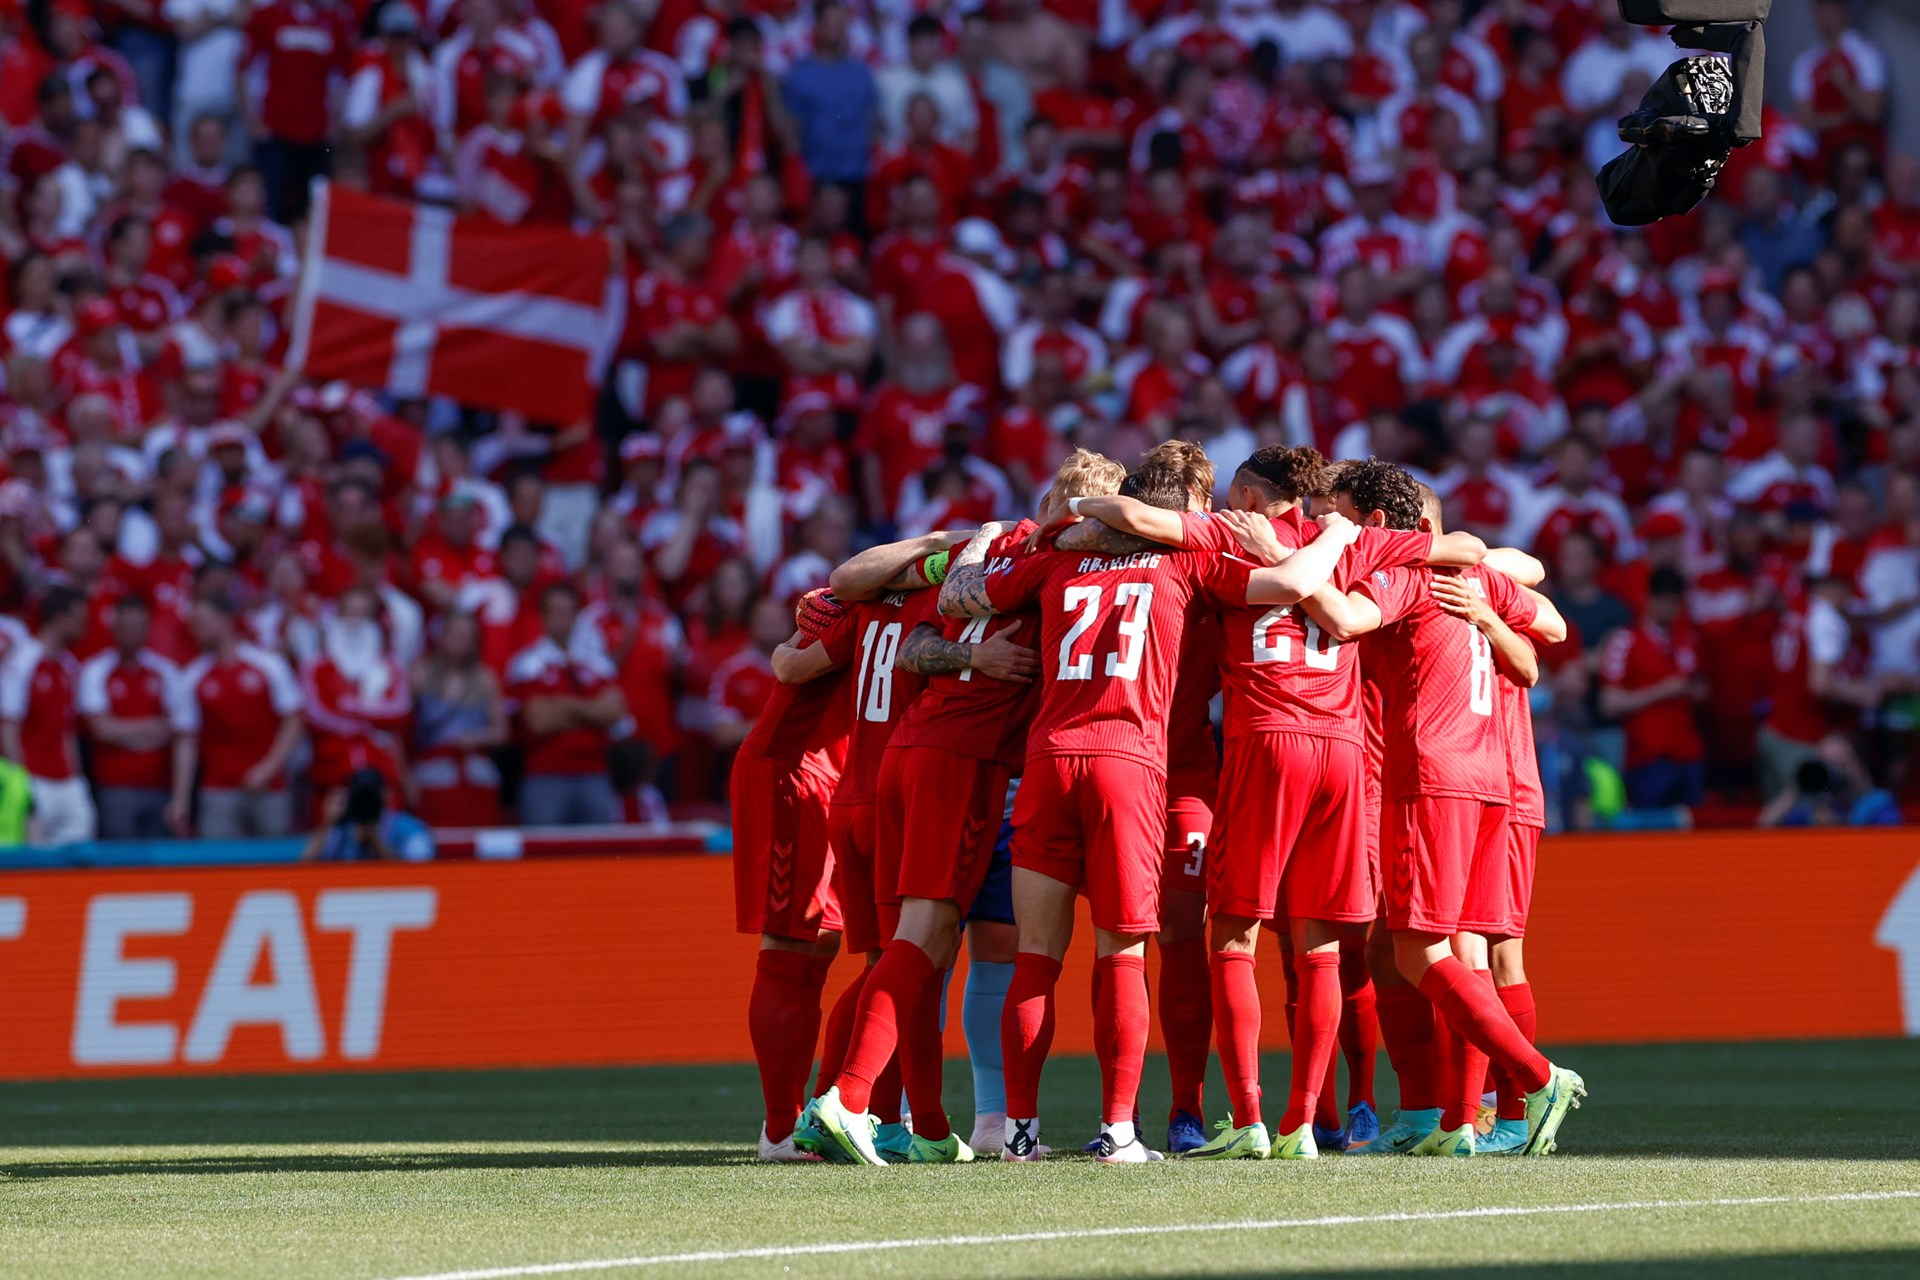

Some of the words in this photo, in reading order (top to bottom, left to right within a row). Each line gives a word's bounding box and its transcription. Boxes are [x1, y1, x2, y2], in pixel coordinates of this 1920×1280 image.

[856, 620, 902, 723] 18
[1057, 582, 1154, 682] 23
[1467, 623, 1493, 717] 8
[1184, 831, 1206, 877] 3
[72, 887, 438, 1065] EAT
